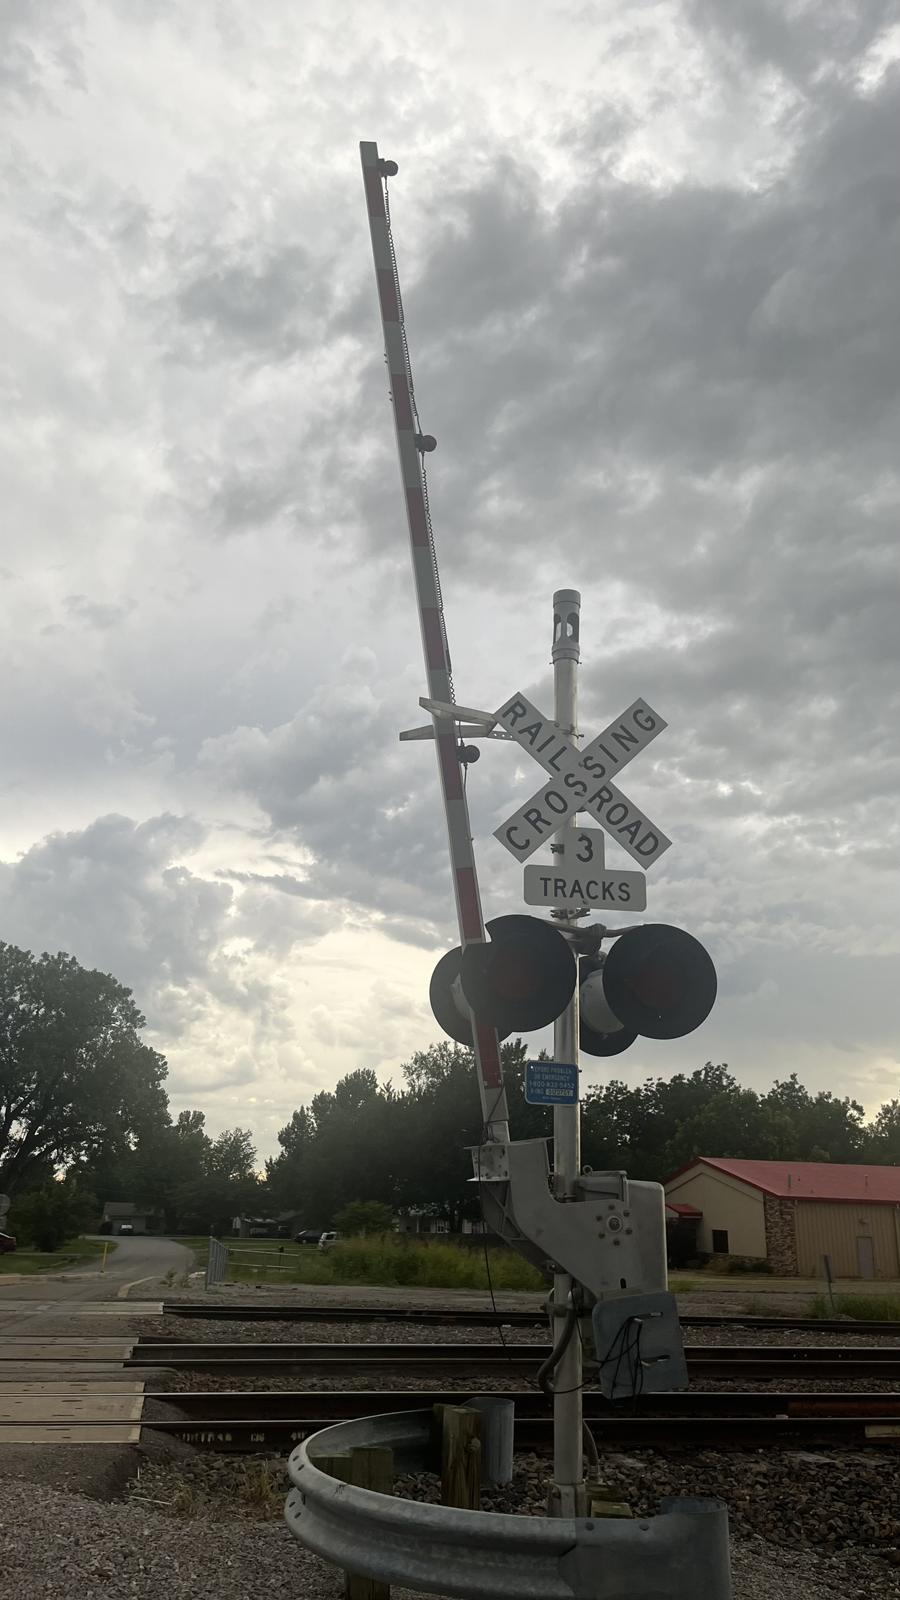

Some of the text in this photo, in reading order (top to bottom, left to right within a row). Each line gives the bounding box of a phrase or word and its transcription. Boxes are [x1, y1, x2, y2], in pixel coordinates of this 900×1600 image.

[502, 700, 659, 856] RAIL ROAD
[506, 709, 656, 851] CROSSING
[539, 876, 631, 902] TRACKS
[576, 835, 594, 863] 3
